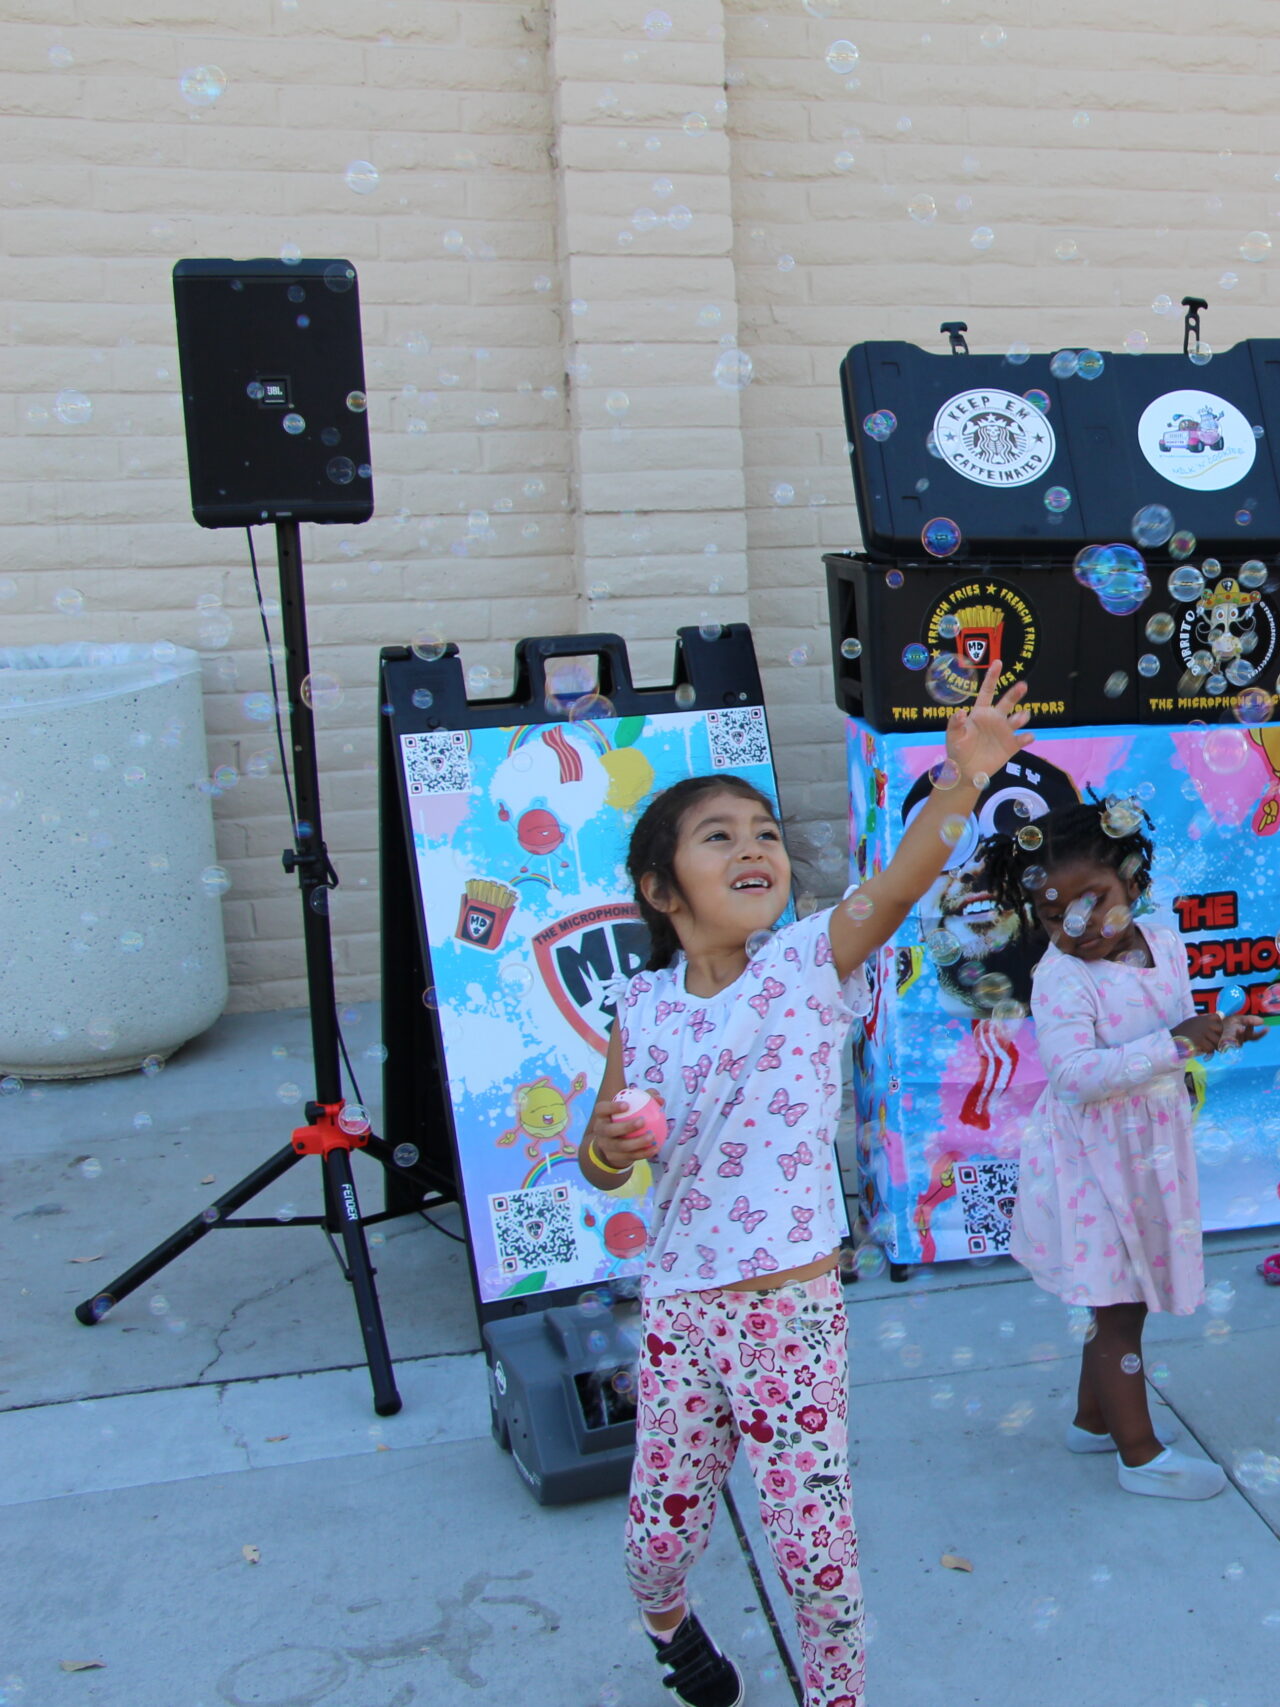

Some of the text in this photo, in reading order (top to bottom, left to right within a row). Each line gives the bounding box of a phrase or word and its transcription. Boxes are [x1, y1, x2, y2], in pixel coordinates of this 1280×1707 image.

[266, 386, 283, 396] JBL
[947, 395, 1030, 421] KEEP EM
[953, 453, 1043, 481] CAFFEINATED
[928, 584, 980, 644] FRENCH FRIES
[1000, 588, 1035, 659] FRENCH FRIES
[968, 642, 984, 651] MD
[1179, 610, 1201, 676] BURRITO
[892, 706, 918, 721] THE
[1009, 701, 1065, 715] OCTORS
[1149, 698, 1173, 711] THE
[1178, 694, 1252, 710] MICROPHONE
[470, 914, 488, 928] MD
[1174, 892, 1237, 932] THE
[534, 906, 638, 946] THE MICROPHONE
